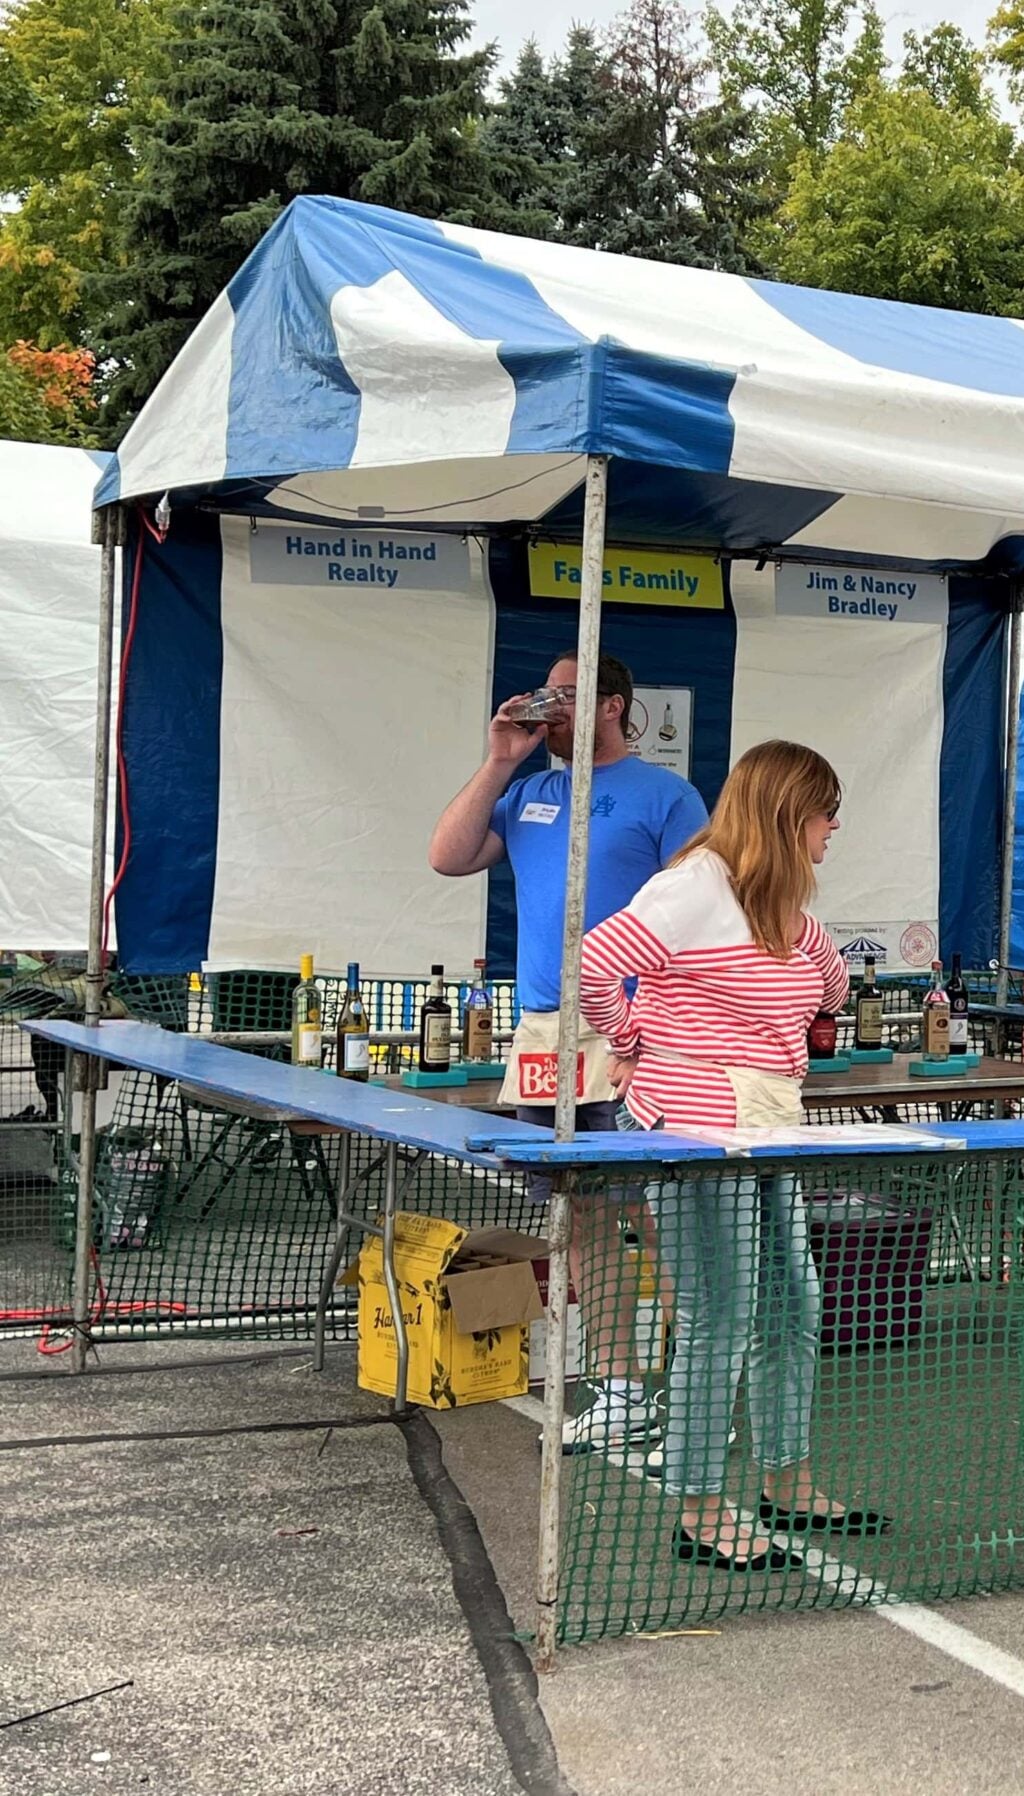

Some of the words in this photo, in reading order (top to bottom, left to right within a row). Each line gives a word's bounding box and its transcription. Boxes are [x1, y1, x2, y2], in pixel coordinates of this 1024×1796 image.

[286, 536, 346, 557] Hand
[352, 539, 372, 558] in
[378, 541, 436, 561] Hand
[328, 562, 399, 587] Realty
[554, 561, 613, 586] Fas
[619, 566, 699, 597] Family
[806, 572, 838, 591] Jim
[843, 575, 857, 592] &
[861, 576, 917, 600] Nancy
[828, 596, 898, 621] Bradley
[416, 1302, 423, 1325] 1
